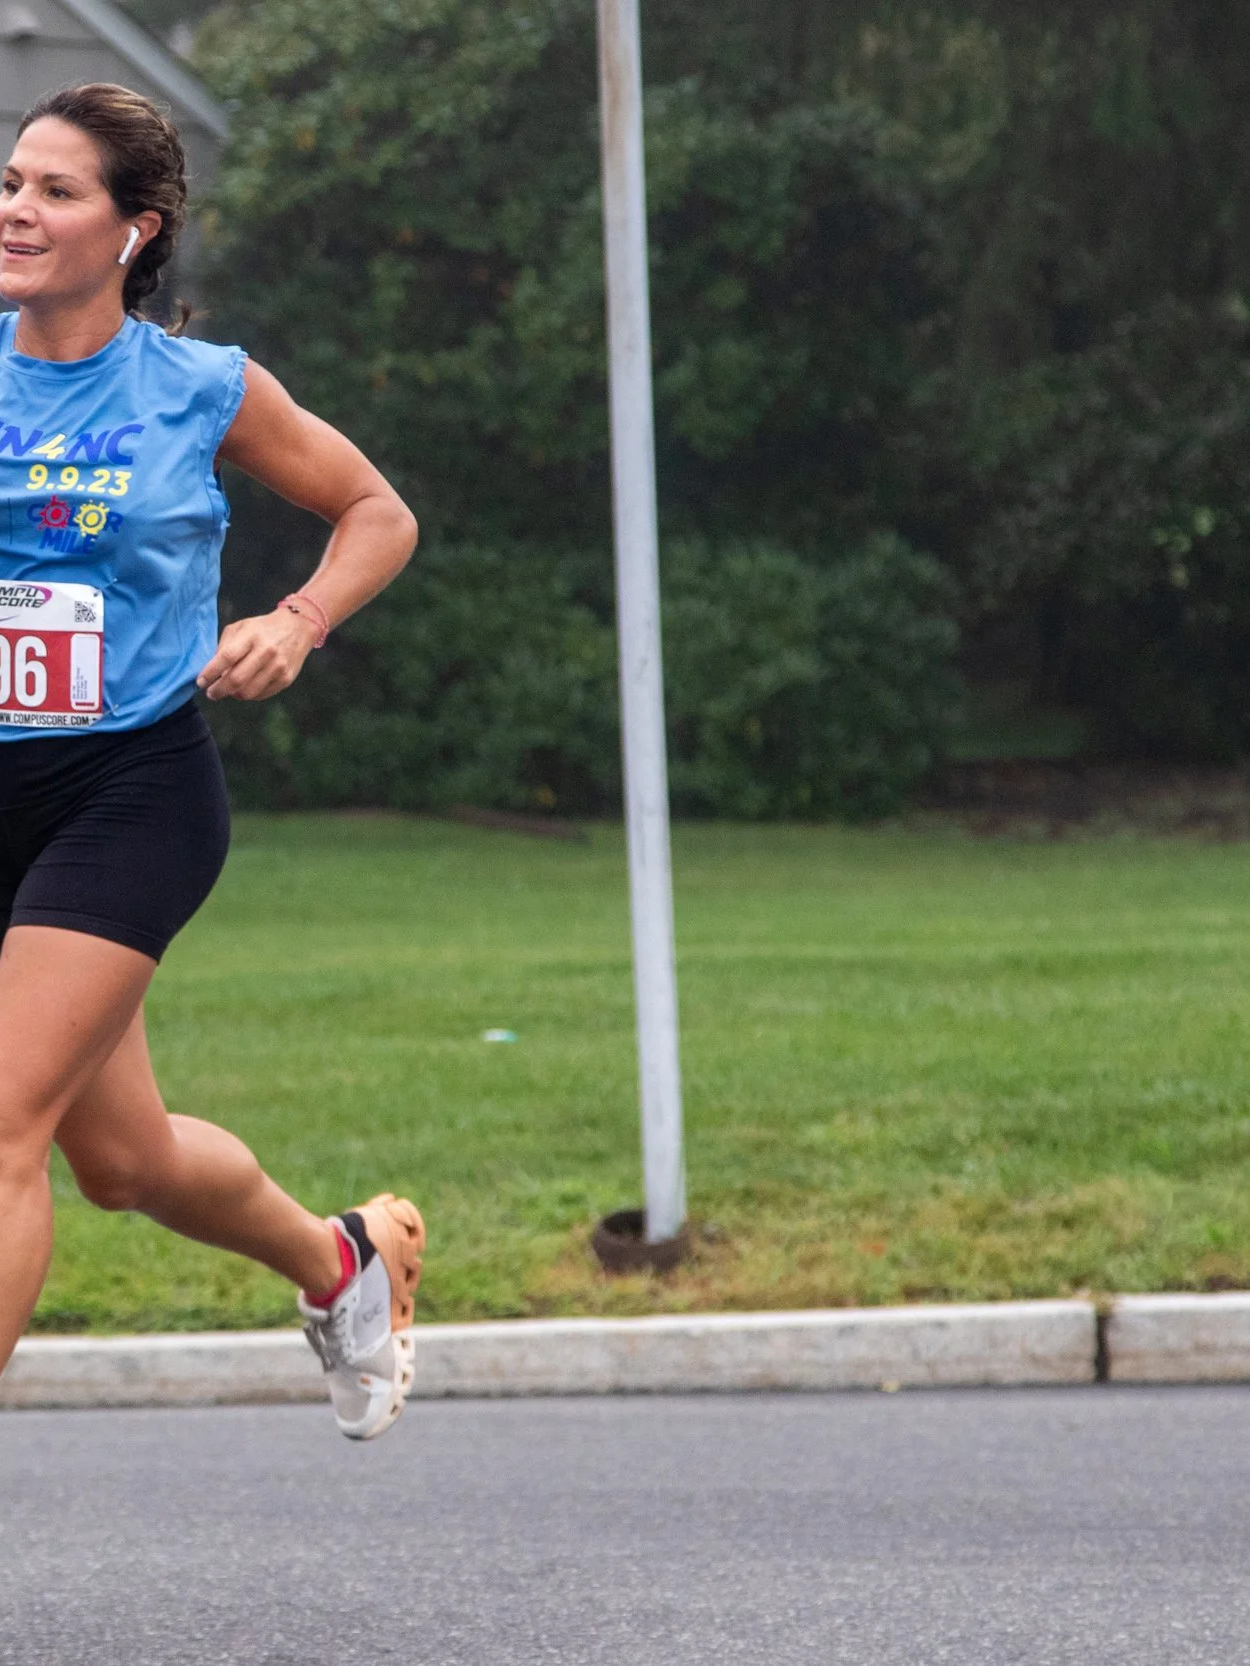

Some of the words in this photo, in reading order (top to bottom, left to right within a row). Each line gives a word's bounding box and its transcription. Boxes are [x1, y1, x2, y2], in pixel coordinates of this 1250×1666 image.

[26, 464, 132, 497] 9.9.23
[27, 498, 123, 534] COLOR
[38, 527, 97, 554] MILE
